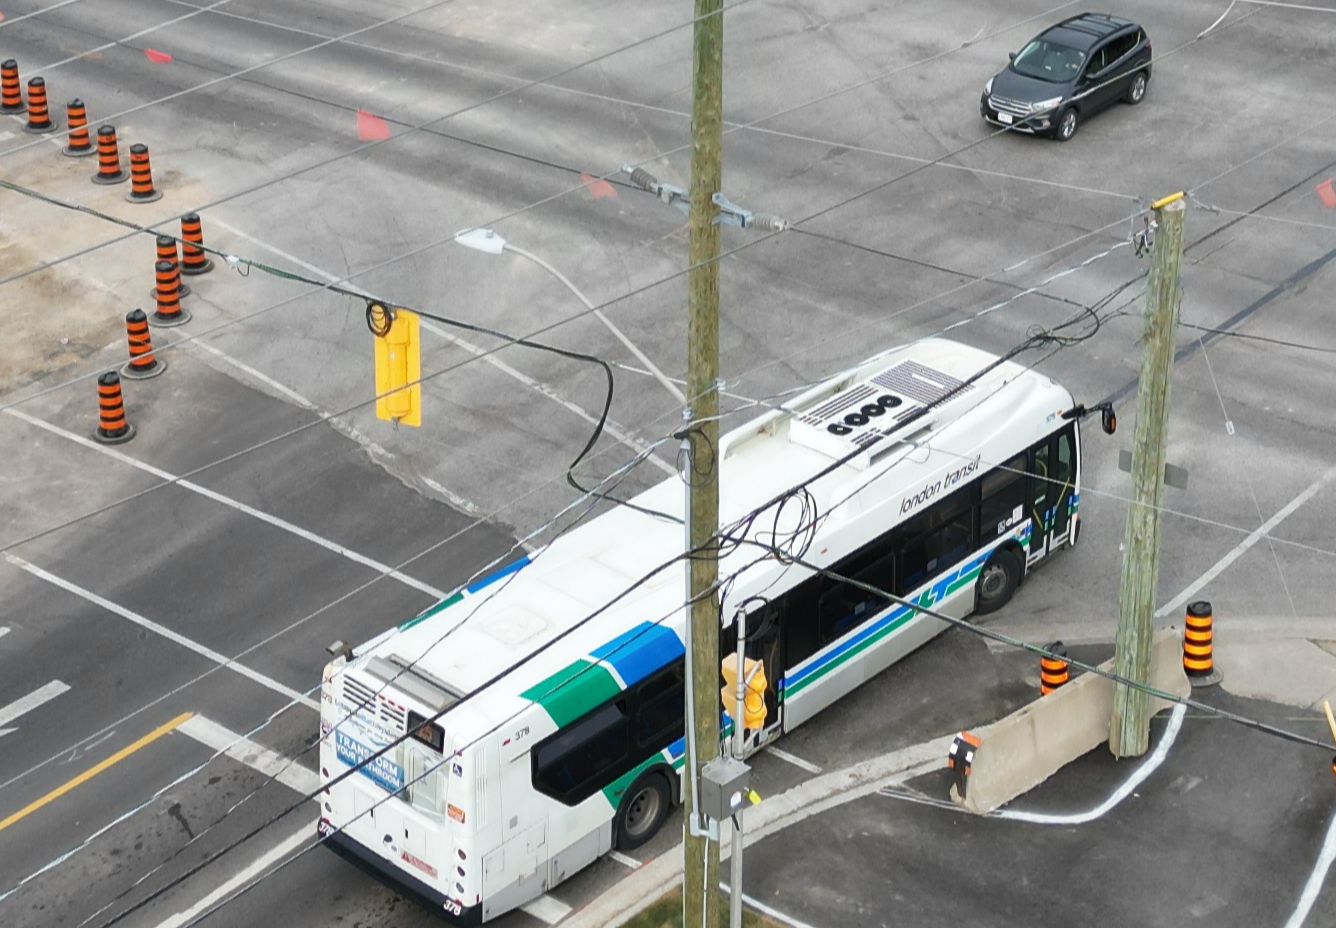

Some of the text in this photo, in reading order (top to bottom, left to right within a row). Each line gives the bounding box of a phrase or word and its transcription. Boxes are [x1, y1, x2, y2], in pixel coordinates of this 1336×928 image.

[899, 453, 981, 516] london transit
[338, 733, 398, 777] TRANSORM
[515, 726, 530, 741] 378
[336, 743, 400, 787] YOUR BTHROOM
[443, 900, 462, 916] 378
